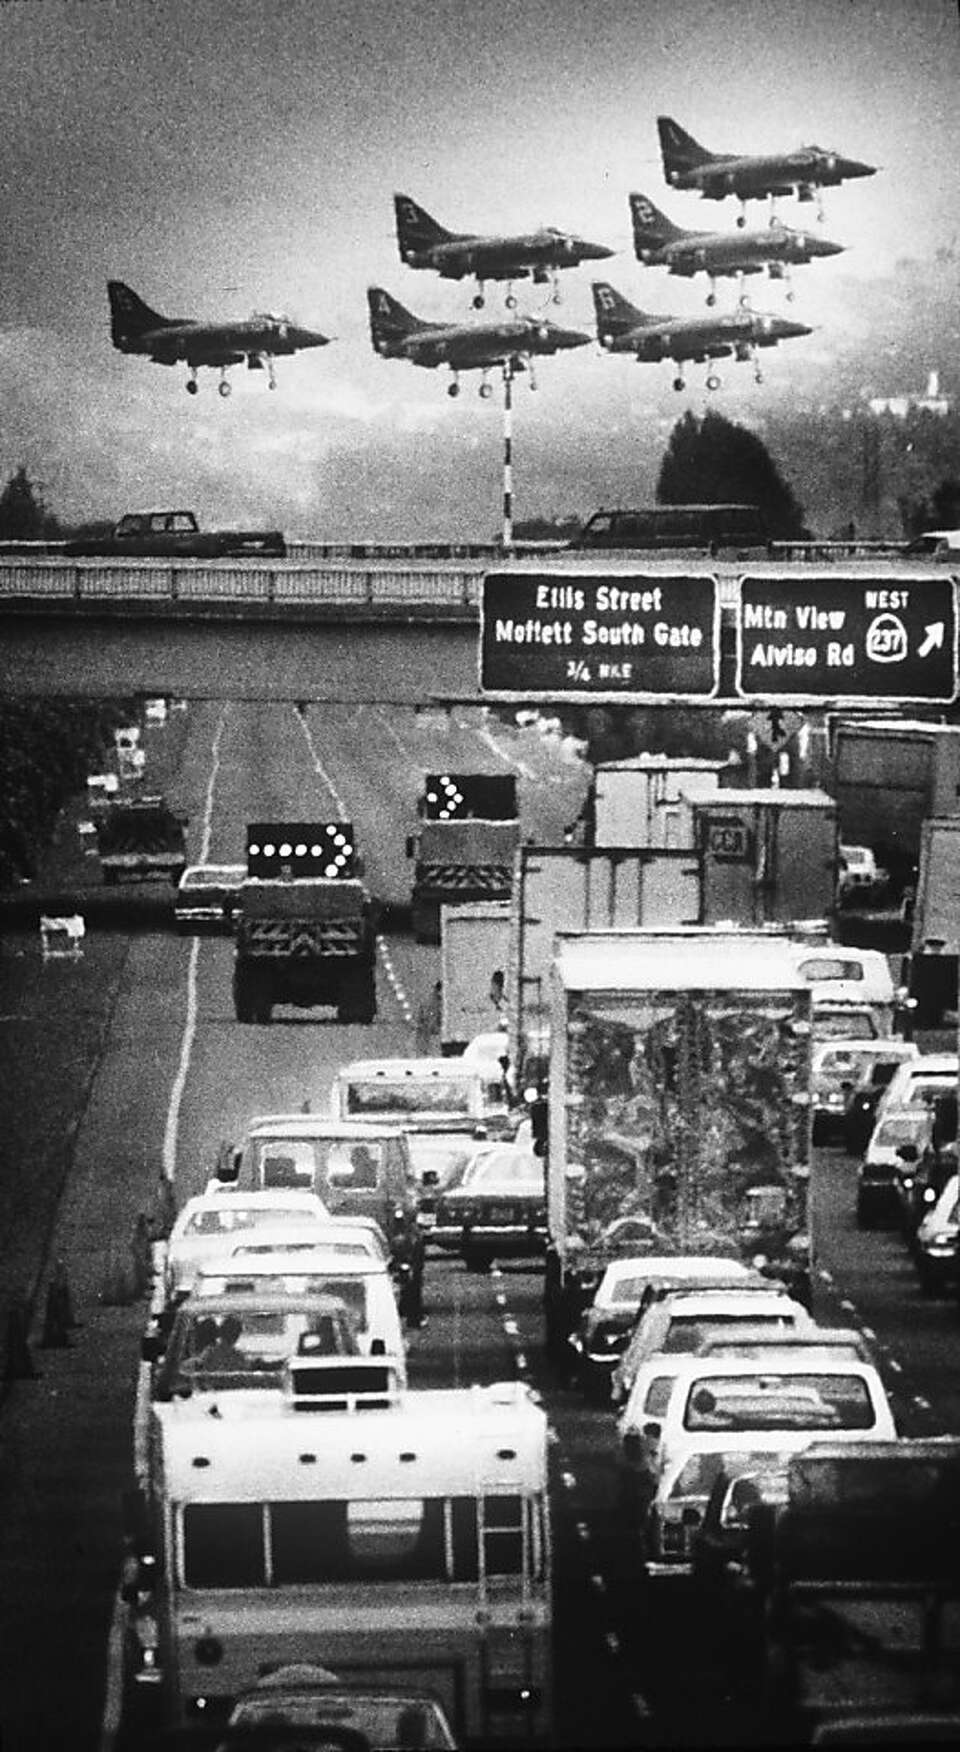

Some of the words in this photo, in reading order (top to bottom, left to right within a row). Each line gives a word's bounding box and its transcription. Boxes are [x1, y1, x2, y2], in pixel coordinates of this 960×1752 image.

[402, 203, 419, 223] 3
[634, 199, 655, 224] 2
[598, 287, 615, 310] 6
[536, 585, 585, 611] Ellis
[596, 585, 662, 612] Street
[865, 590, 909, 609] WEST
[744, 603, 788, 630] Mtn
[795, 605, 846, 631] View
[495, 619, 573, 645] Moffett
[581, 619, 645, 646] South
[653, 621, 703, 647] Gate
[871, 628, 901, 653] 237
[750, 642, 818, 668] Alviso
[826, 641, 855, 667] Rd
